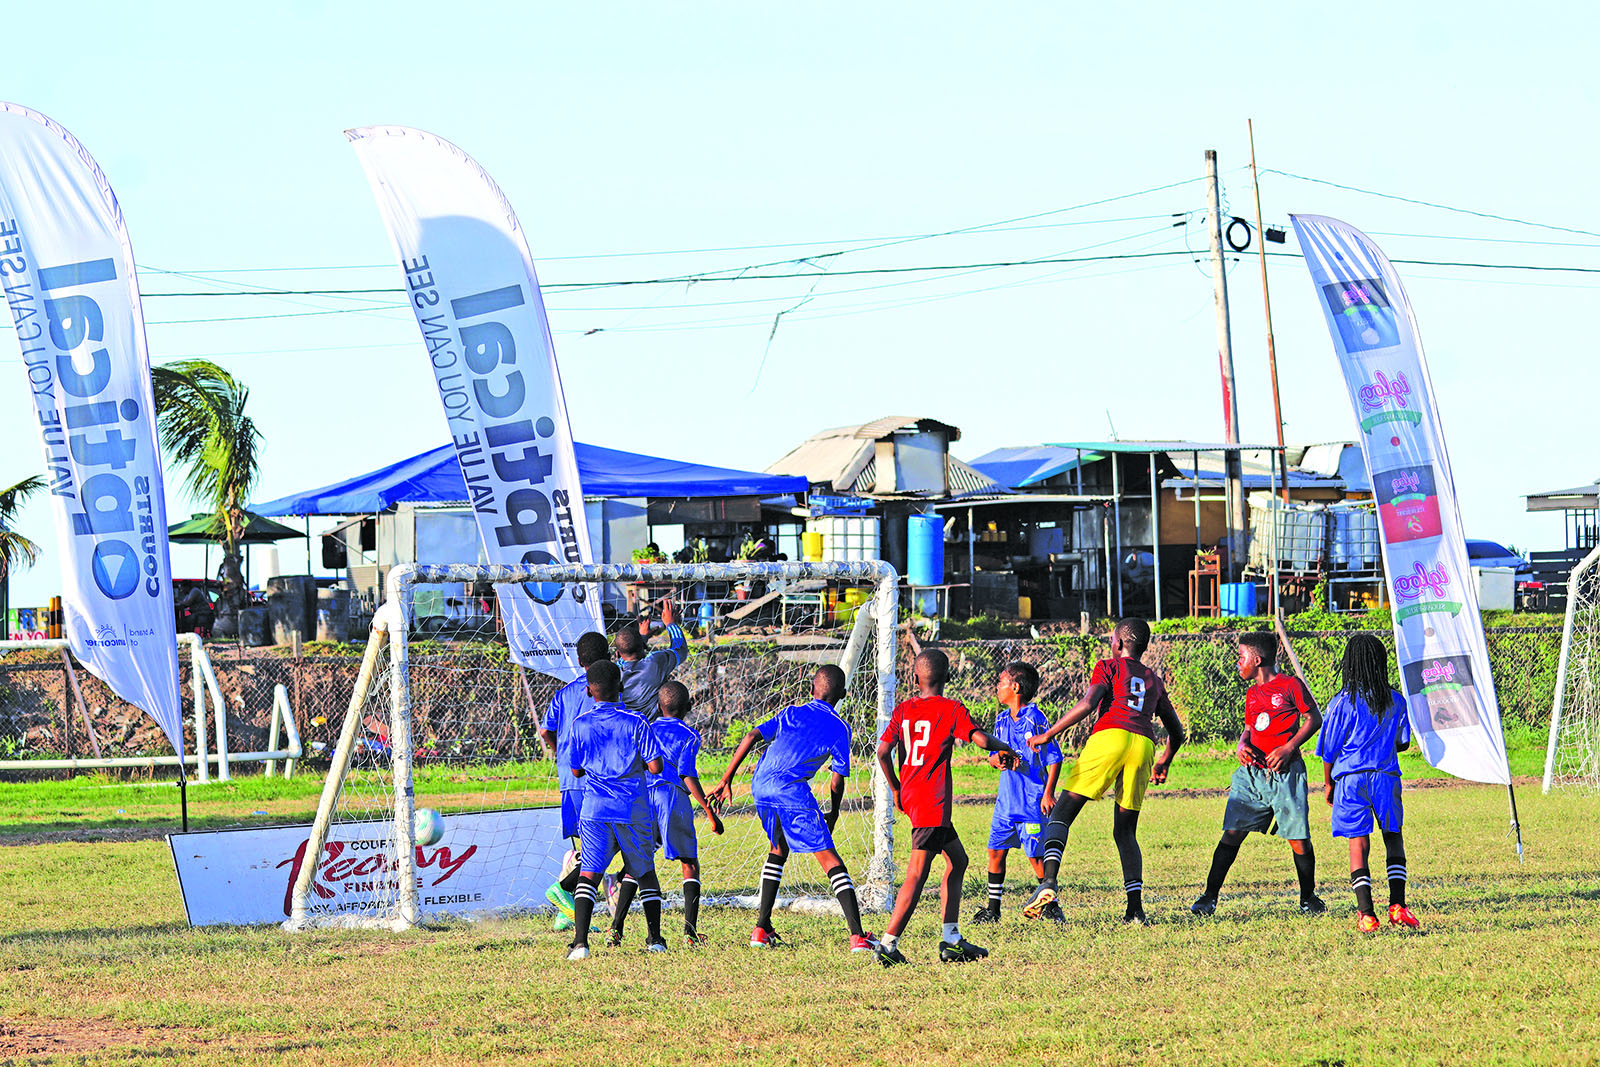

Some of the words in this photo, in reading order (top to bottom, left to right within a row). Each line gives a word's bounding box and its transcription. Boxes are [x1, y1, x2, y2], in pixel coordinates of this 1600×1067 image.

[1127, 676, 1146, 712] 9
[901, 719, 931, 767] 12
[424, 892, 485, 906] FLEXIBLE.
